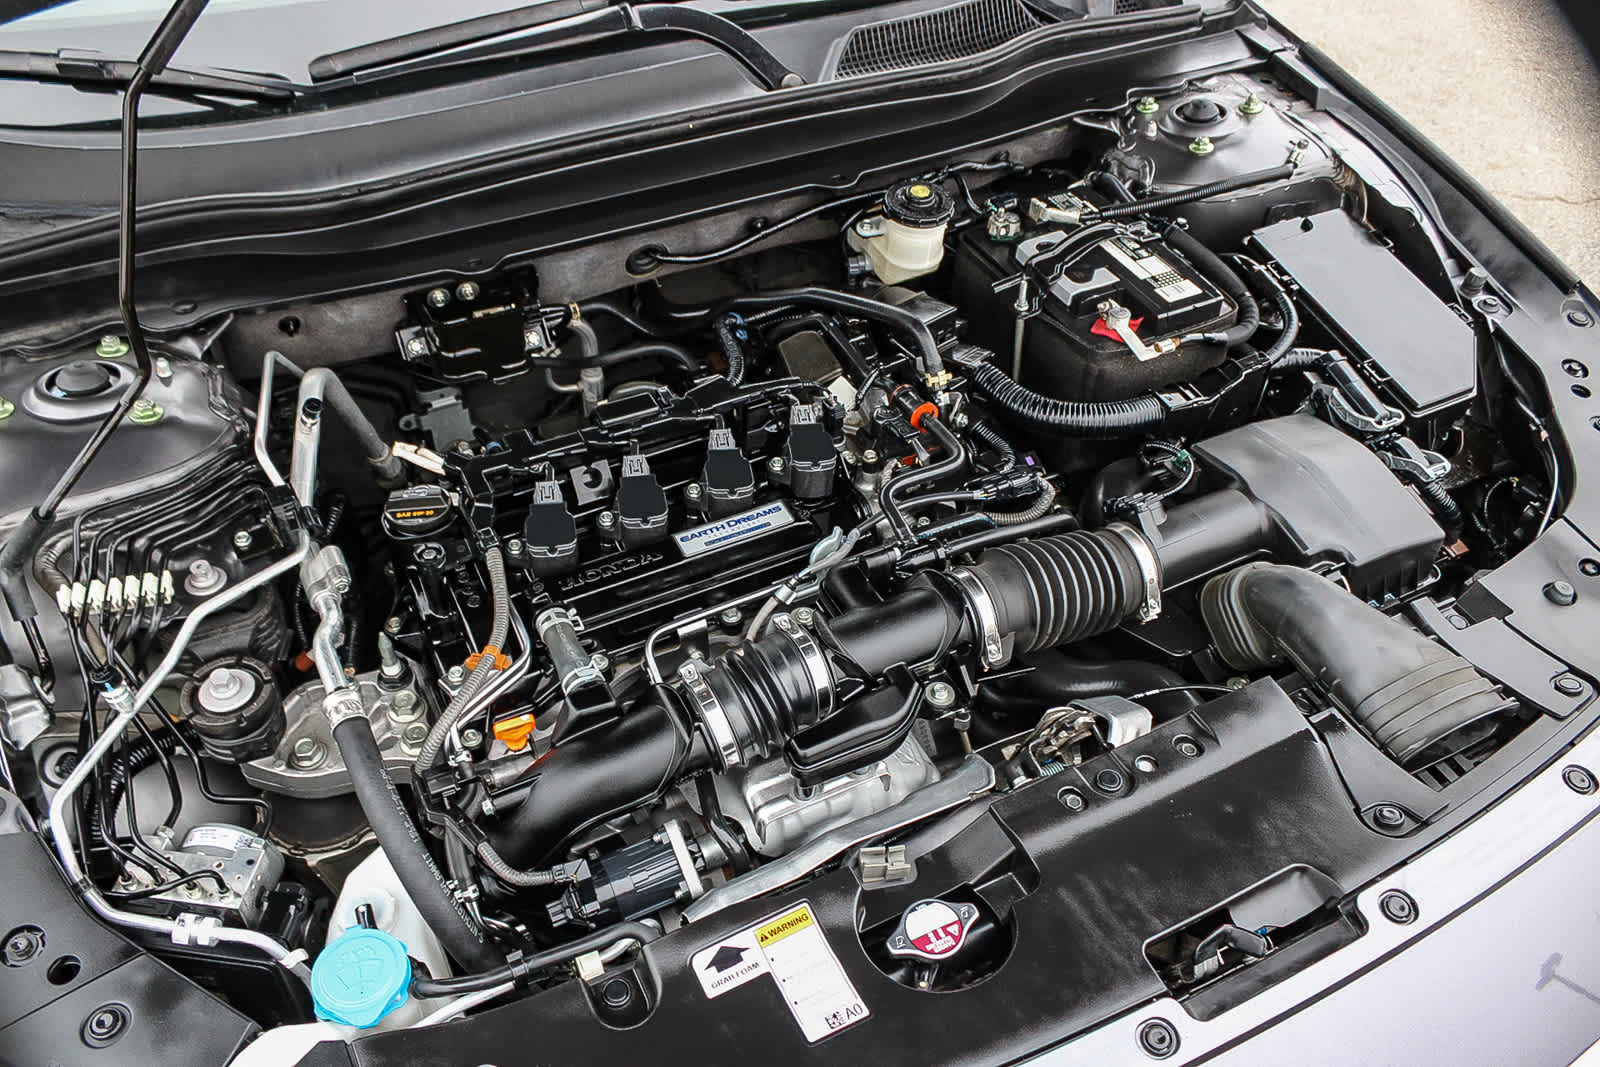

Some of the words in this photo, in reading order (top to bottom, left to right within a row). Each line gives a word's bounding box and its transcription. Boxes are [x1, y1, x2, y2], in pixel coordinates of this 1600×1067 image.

[679, 525, 726, 542] EARTH
[727, 505, 782, 527] DREAMS
[558, 552, 663, 591] HONDA
[767, 913, 809, 937] WARNING
